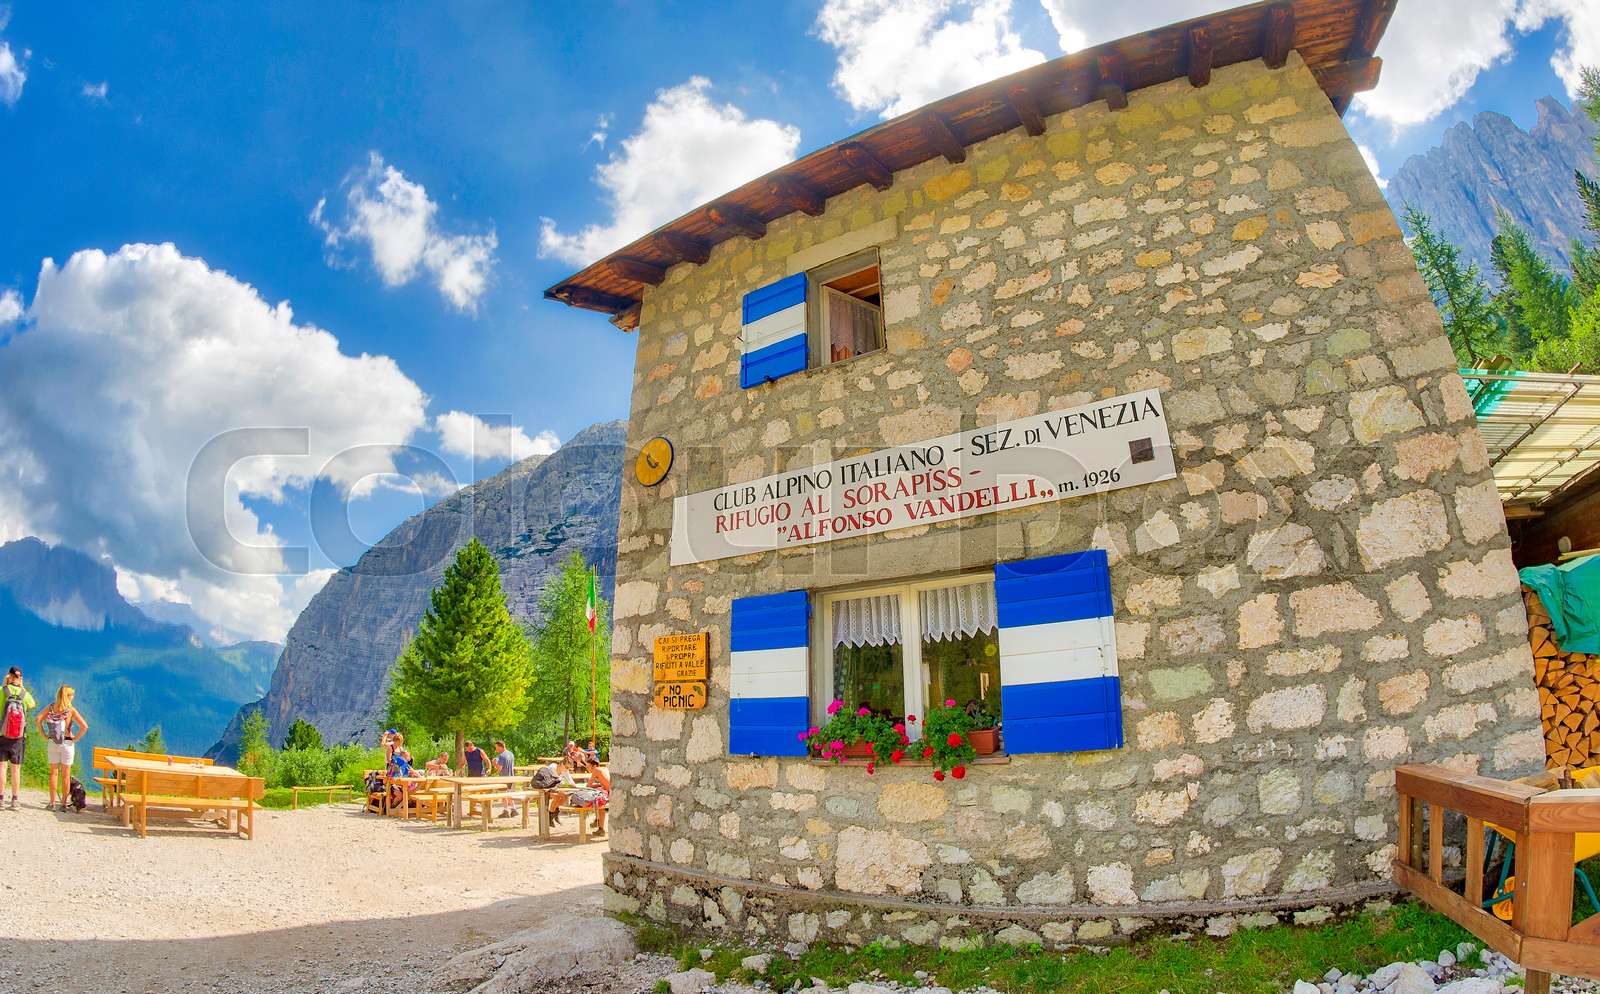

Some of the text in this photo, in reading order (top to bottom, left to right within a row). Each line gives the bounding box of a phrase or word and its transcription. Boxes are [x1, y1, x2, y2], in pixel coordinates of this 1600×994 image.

[713, 486, 756, 511] CLUB
[761, 469, 832, 501] ALPINO
[840, 445, 945, 485] ITALIANO
[971, 428, 1021, 456] SEZ.
[1024, 427, 1041, 446] DI
[1044, 396, 1160, 441] VENEZIA
[1058, 483, 1079, 493] m.
[1083, 467, 1121, 489] 1926
[715, 501, 792, 534] RIFUGIO
[800, 494, 831, 519] AL
[680, 634, 701, 643] PREGA
[684, 659, 705, 668] VALLE
[669, 685, 682, 695] NO
[663, 694, 695, 708] PICNIC
